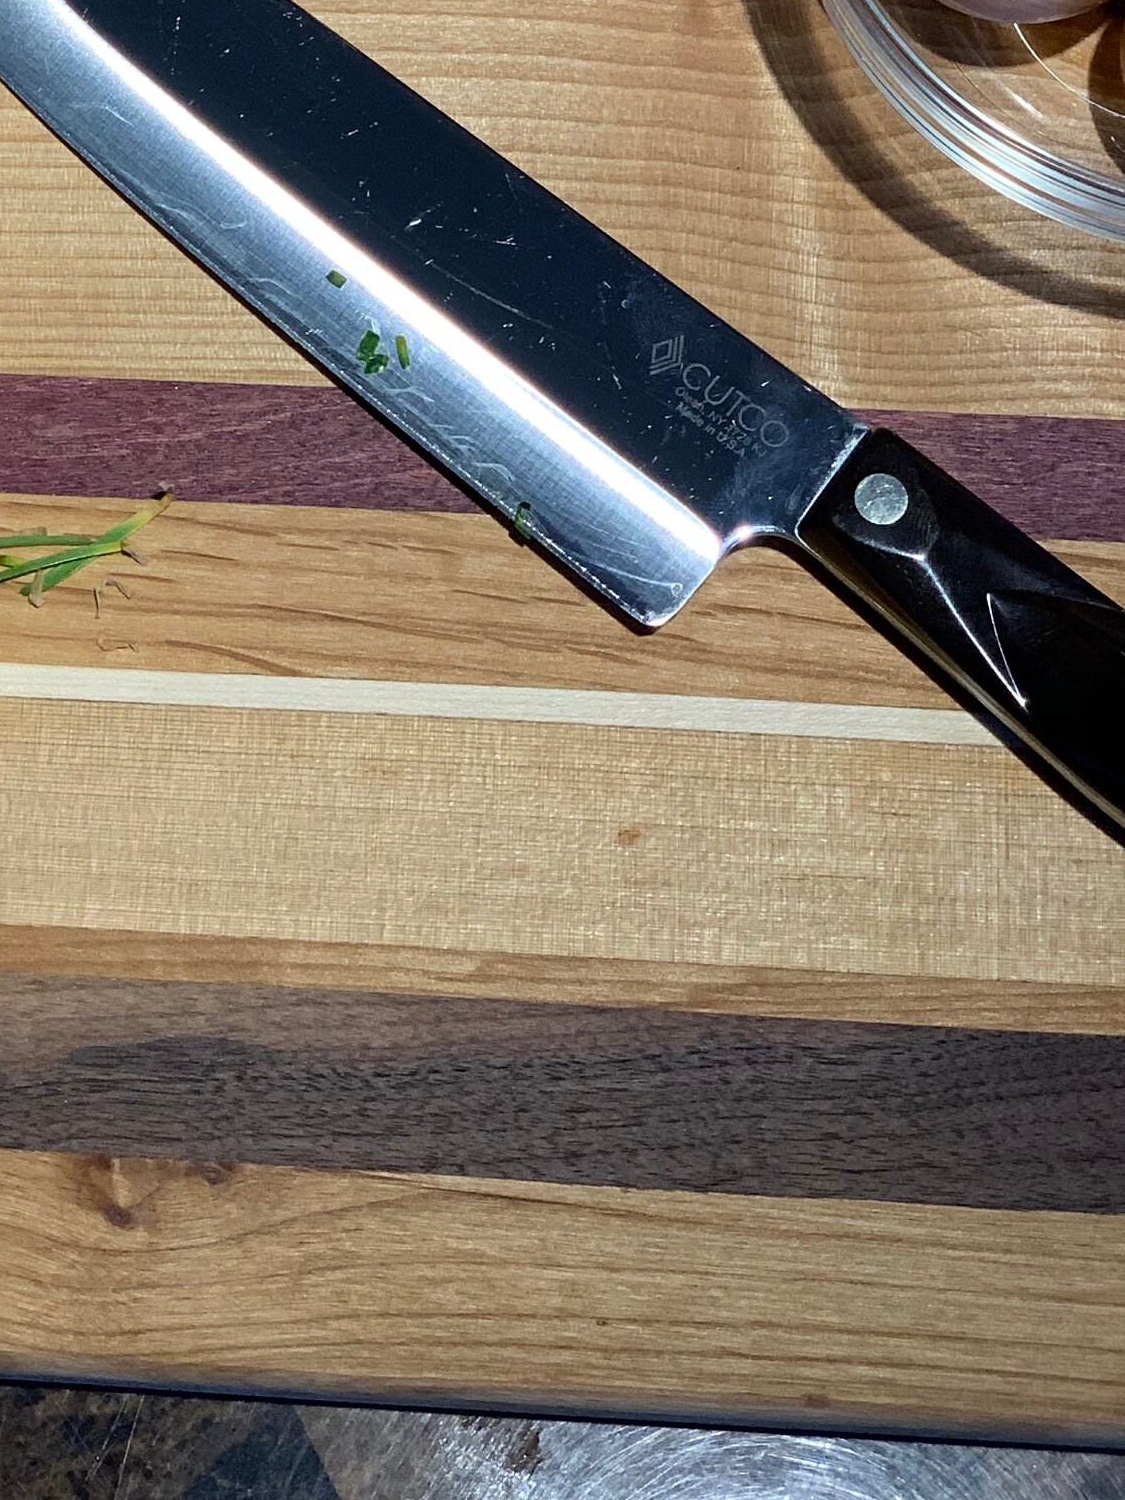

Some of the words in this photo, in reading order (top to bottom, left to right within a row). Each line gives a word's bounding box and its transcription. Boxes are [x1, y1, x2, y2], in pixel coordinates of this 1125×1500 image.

[683, 363, 789, 448] CUTCO
[707, 410, 728, 426] NY
[704, 423, 716, 435] in
